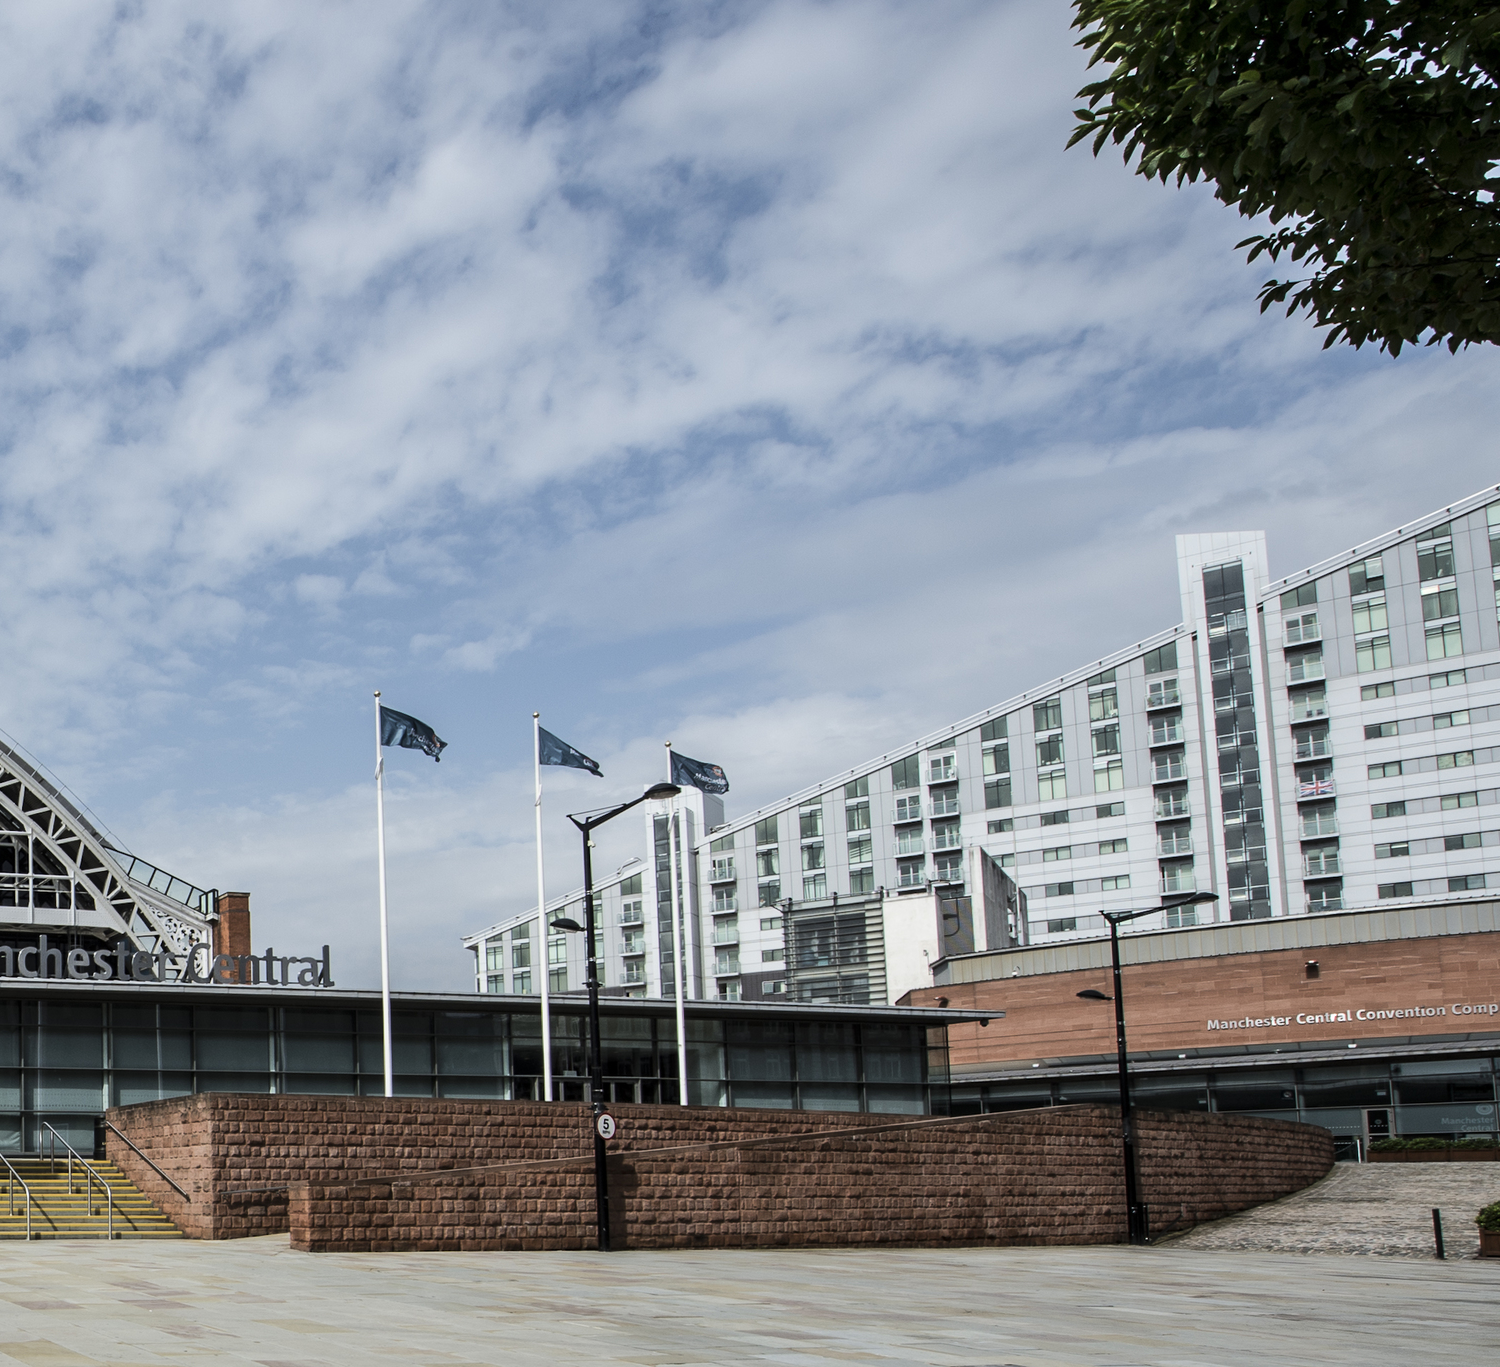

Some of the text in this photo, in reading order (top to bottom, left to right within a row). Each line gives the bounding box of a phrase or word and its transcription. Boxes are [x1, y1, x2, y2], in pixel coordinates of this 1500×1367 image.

[190, 943, 335, 988] Central
[1207, 1002, 1499, 1031] Manchester Central Convention Comp
[603, 1118, 609, 1130] 5
[1441, 1117, 1495, 1125] Manchester
[1460, 1124, 1494, 1132] Central
